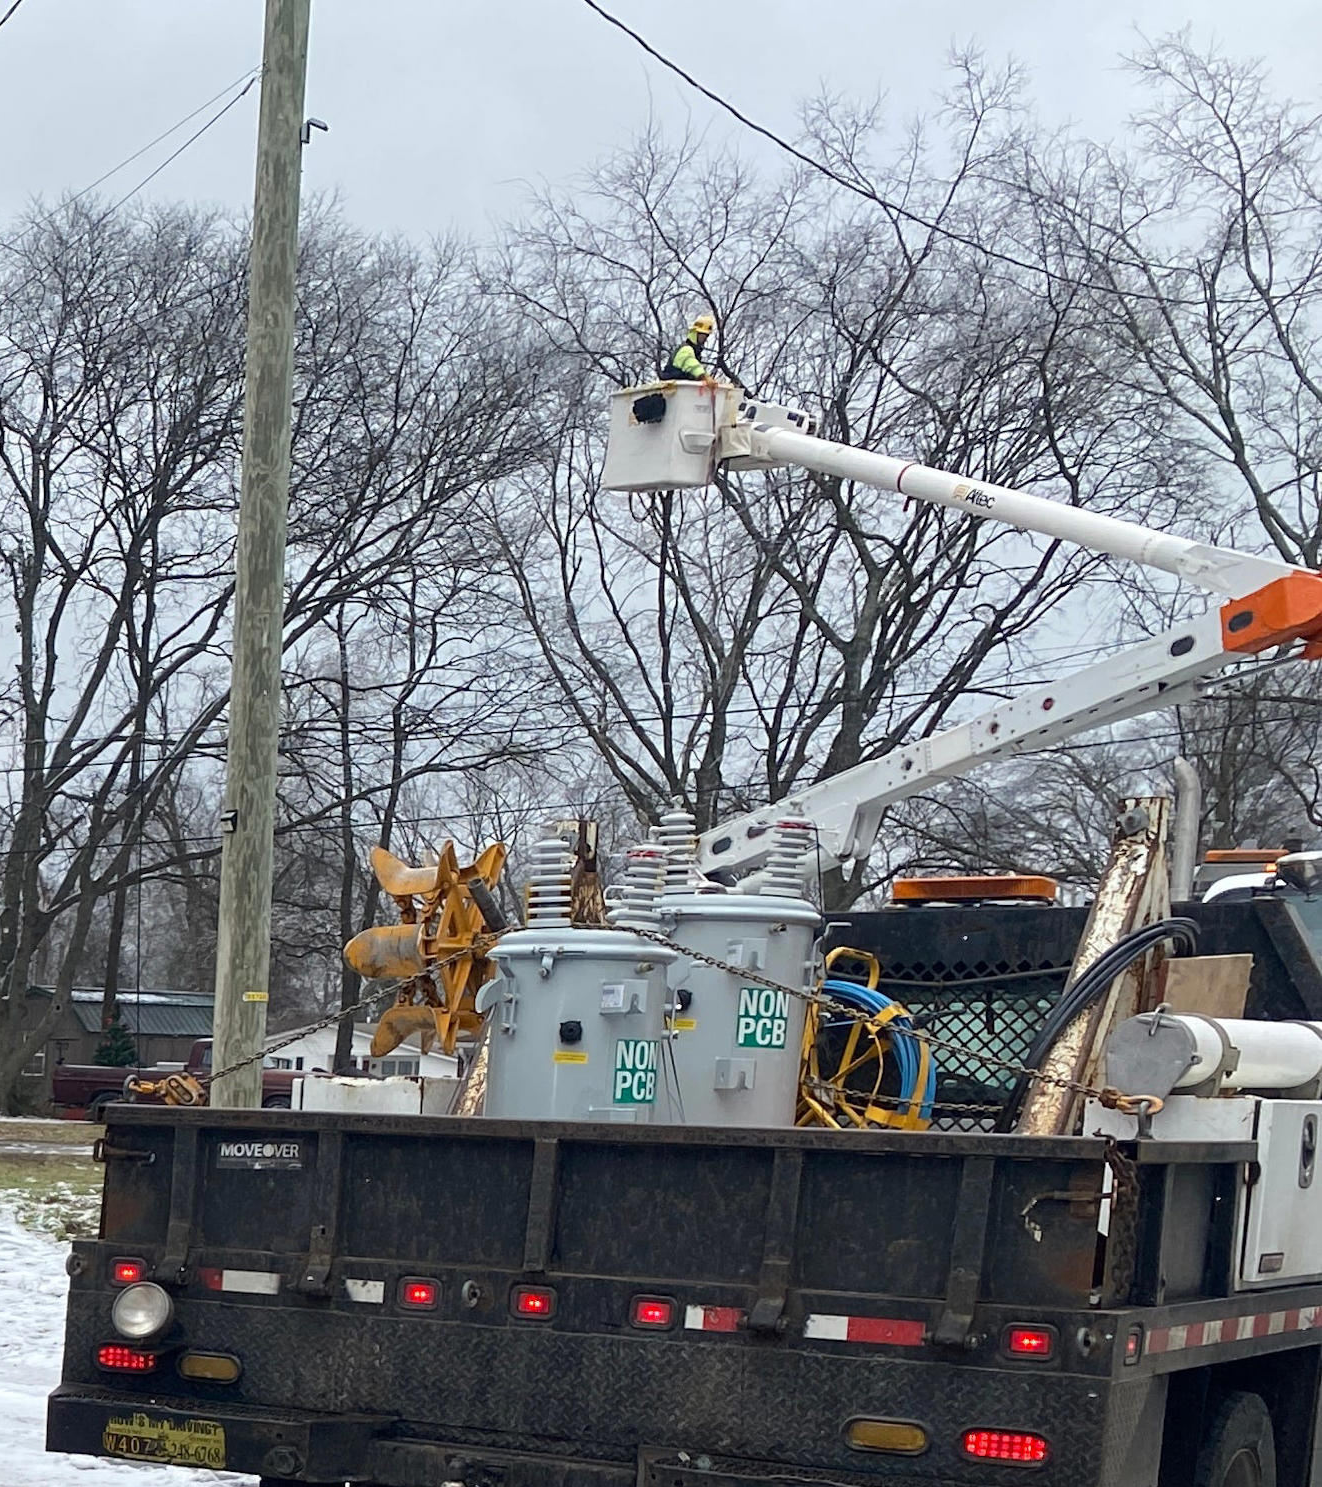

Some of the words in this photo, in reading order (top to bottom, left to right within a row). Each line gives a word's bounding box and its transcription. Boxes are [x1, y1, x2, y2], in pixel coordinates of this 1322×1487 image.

[965, 489, 996, 509] Altec
[739, 989, 790, 1018] NON
[738, 1017, 786, 1047] PCB
[616, 1040, 659, 1070] NON
[615, 1070, 655, 1100] PCB
